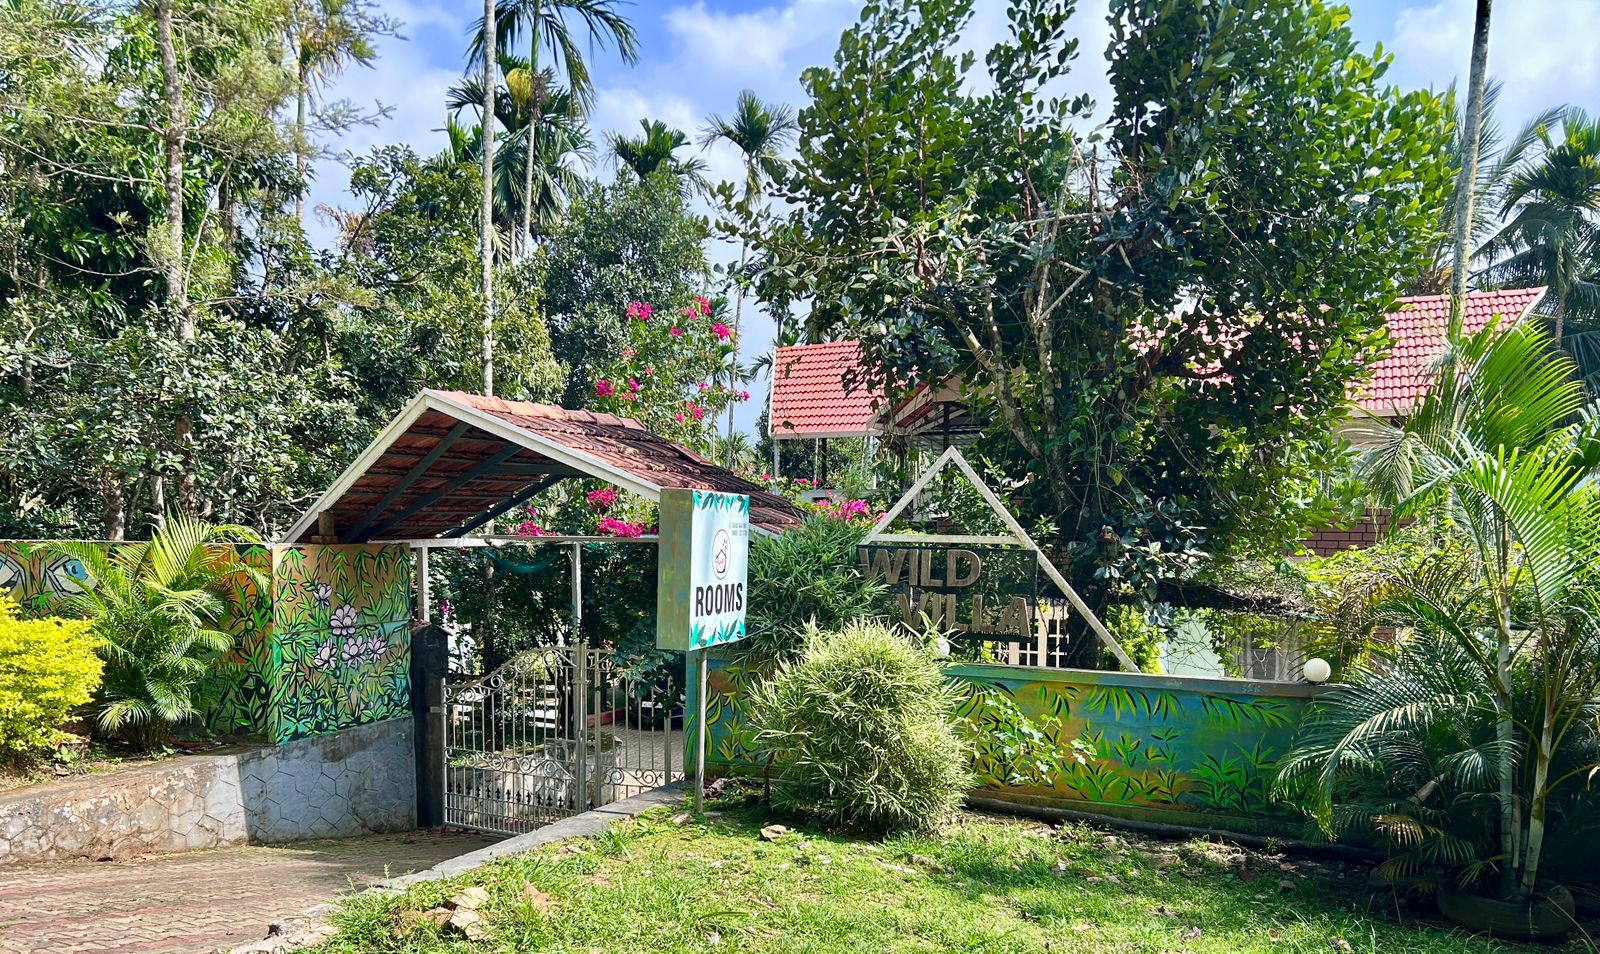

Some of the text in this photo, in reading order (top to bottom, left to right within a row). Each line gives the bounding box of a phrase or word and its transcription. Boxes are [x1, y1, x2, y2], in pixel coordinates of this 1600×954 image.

[858, 548, 982, 587] WILD
[695, 582, 743, 617] ROOMS
[897, 593, 1032, 637] VILLA
